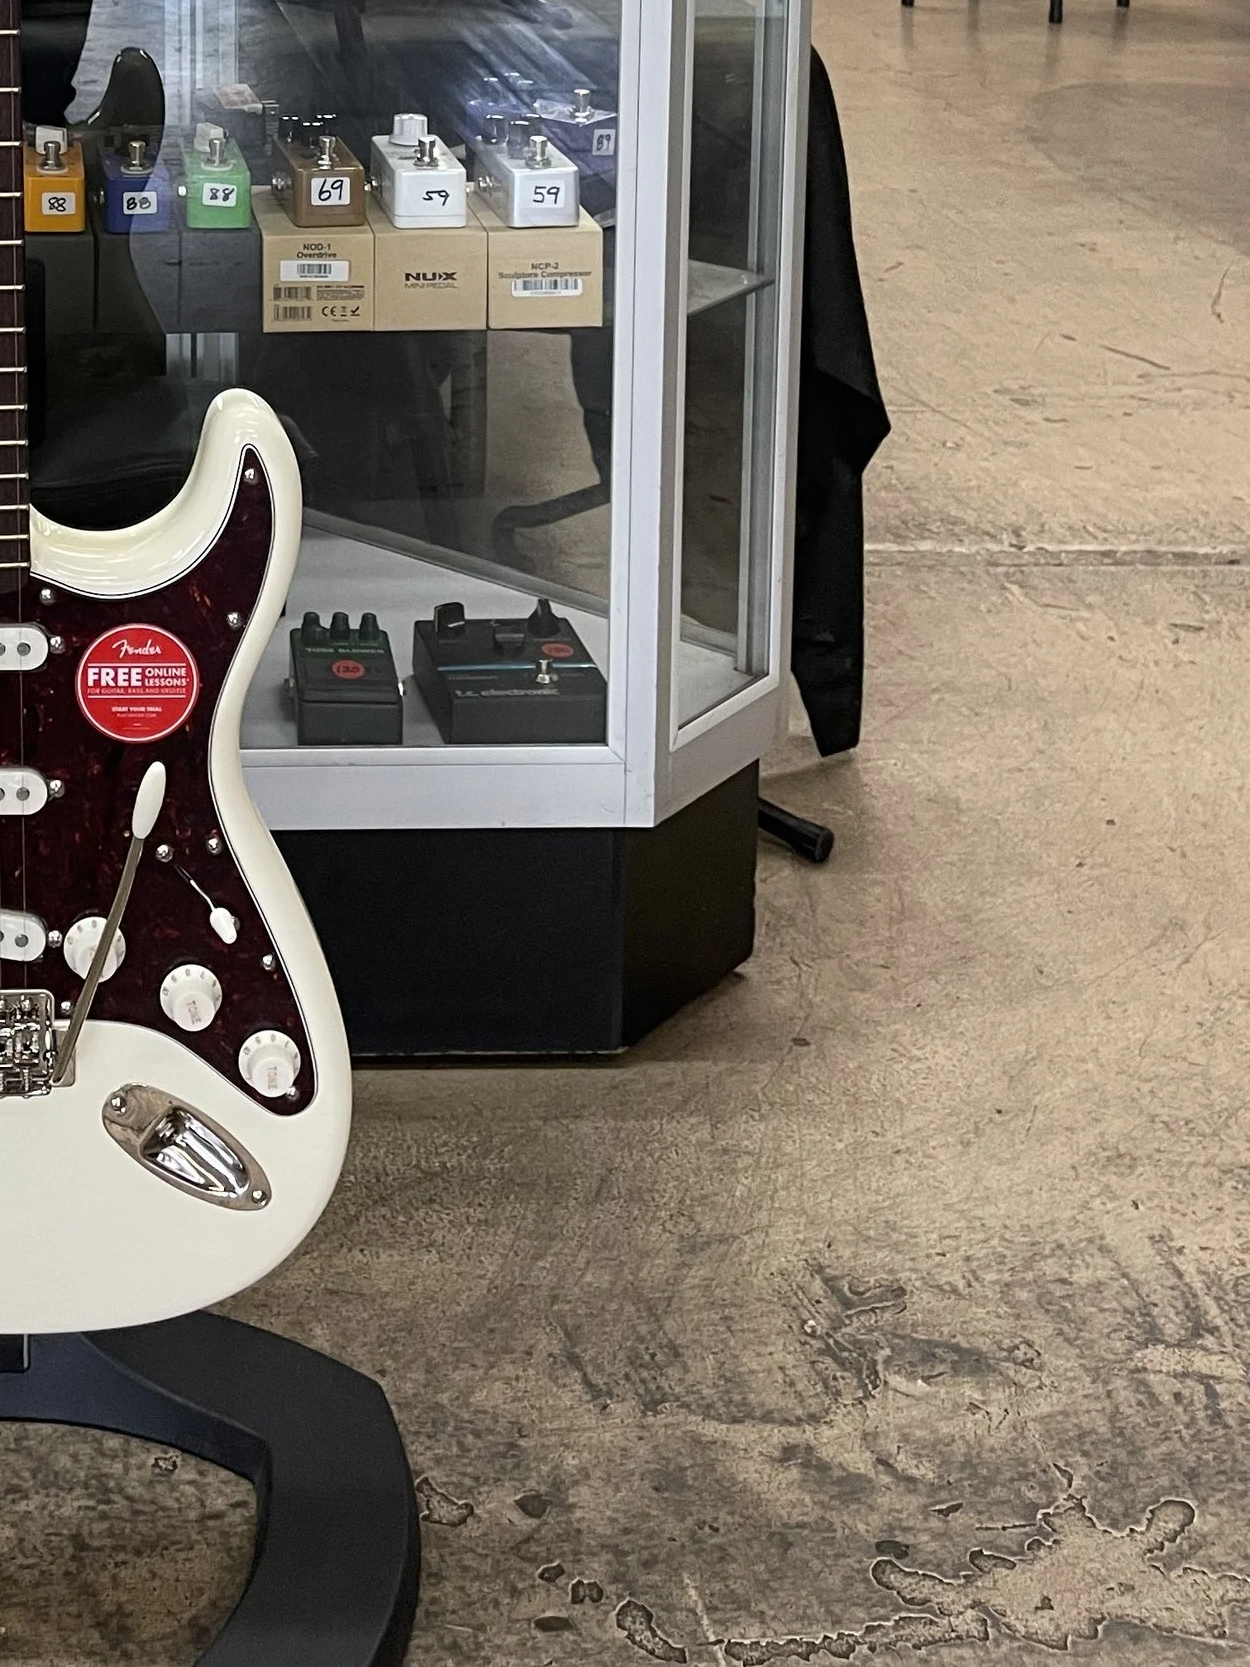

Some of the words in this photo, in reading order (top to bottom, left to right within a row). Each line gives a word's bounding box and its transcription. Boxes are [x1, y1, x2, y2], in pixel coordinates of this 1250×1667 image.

[209, 187, 235, 202] 88
[317, 178, 344, 202] 69
[533, 185, 561, 205] 59
[422, 189, 450, 207] 59
[302, 243, 331, 251] NOD-1
[405, 271, 458, 282] NUX
[540, 269, 593, 280] Compressor
[112, 638, 162, 659] Fender
[87, 667, 143, 687] FREE
[144, 667, 187, 677] ONLINE
[144, 678, 187, 687] LESSONS
